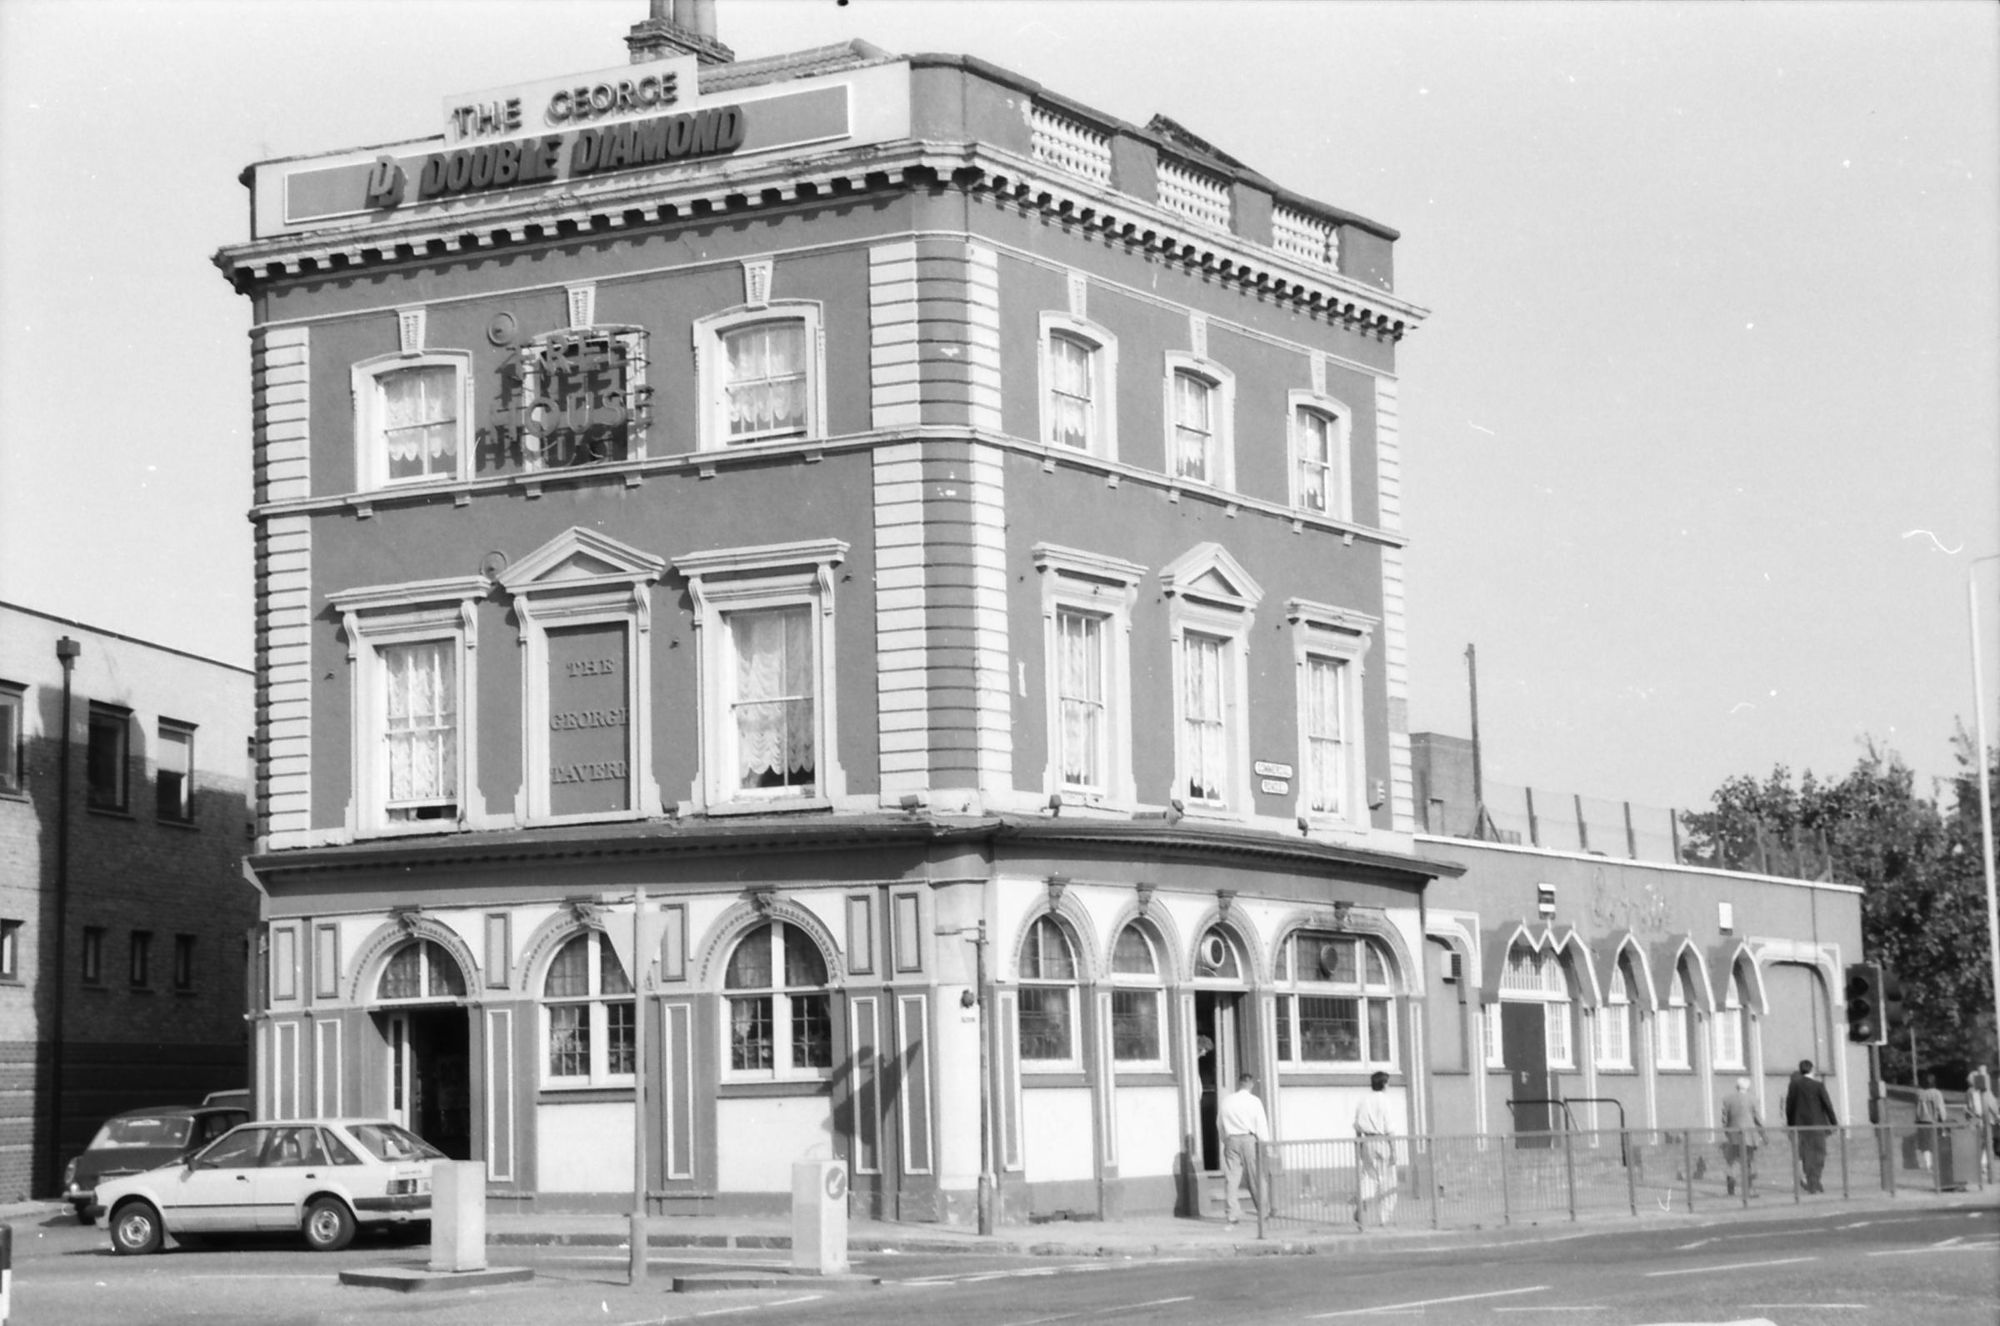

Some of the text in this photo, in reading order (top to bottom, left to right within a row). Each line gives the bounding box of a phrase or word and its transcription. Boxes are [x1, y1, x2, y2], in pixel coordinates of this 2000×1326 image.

[453, 71, 679, 136] THE GEORGE
[421, 134, 563, 198] DOUBLE
[572, 105, 745, 172] DIAMOND
[566, 658, 614, 677] THE
